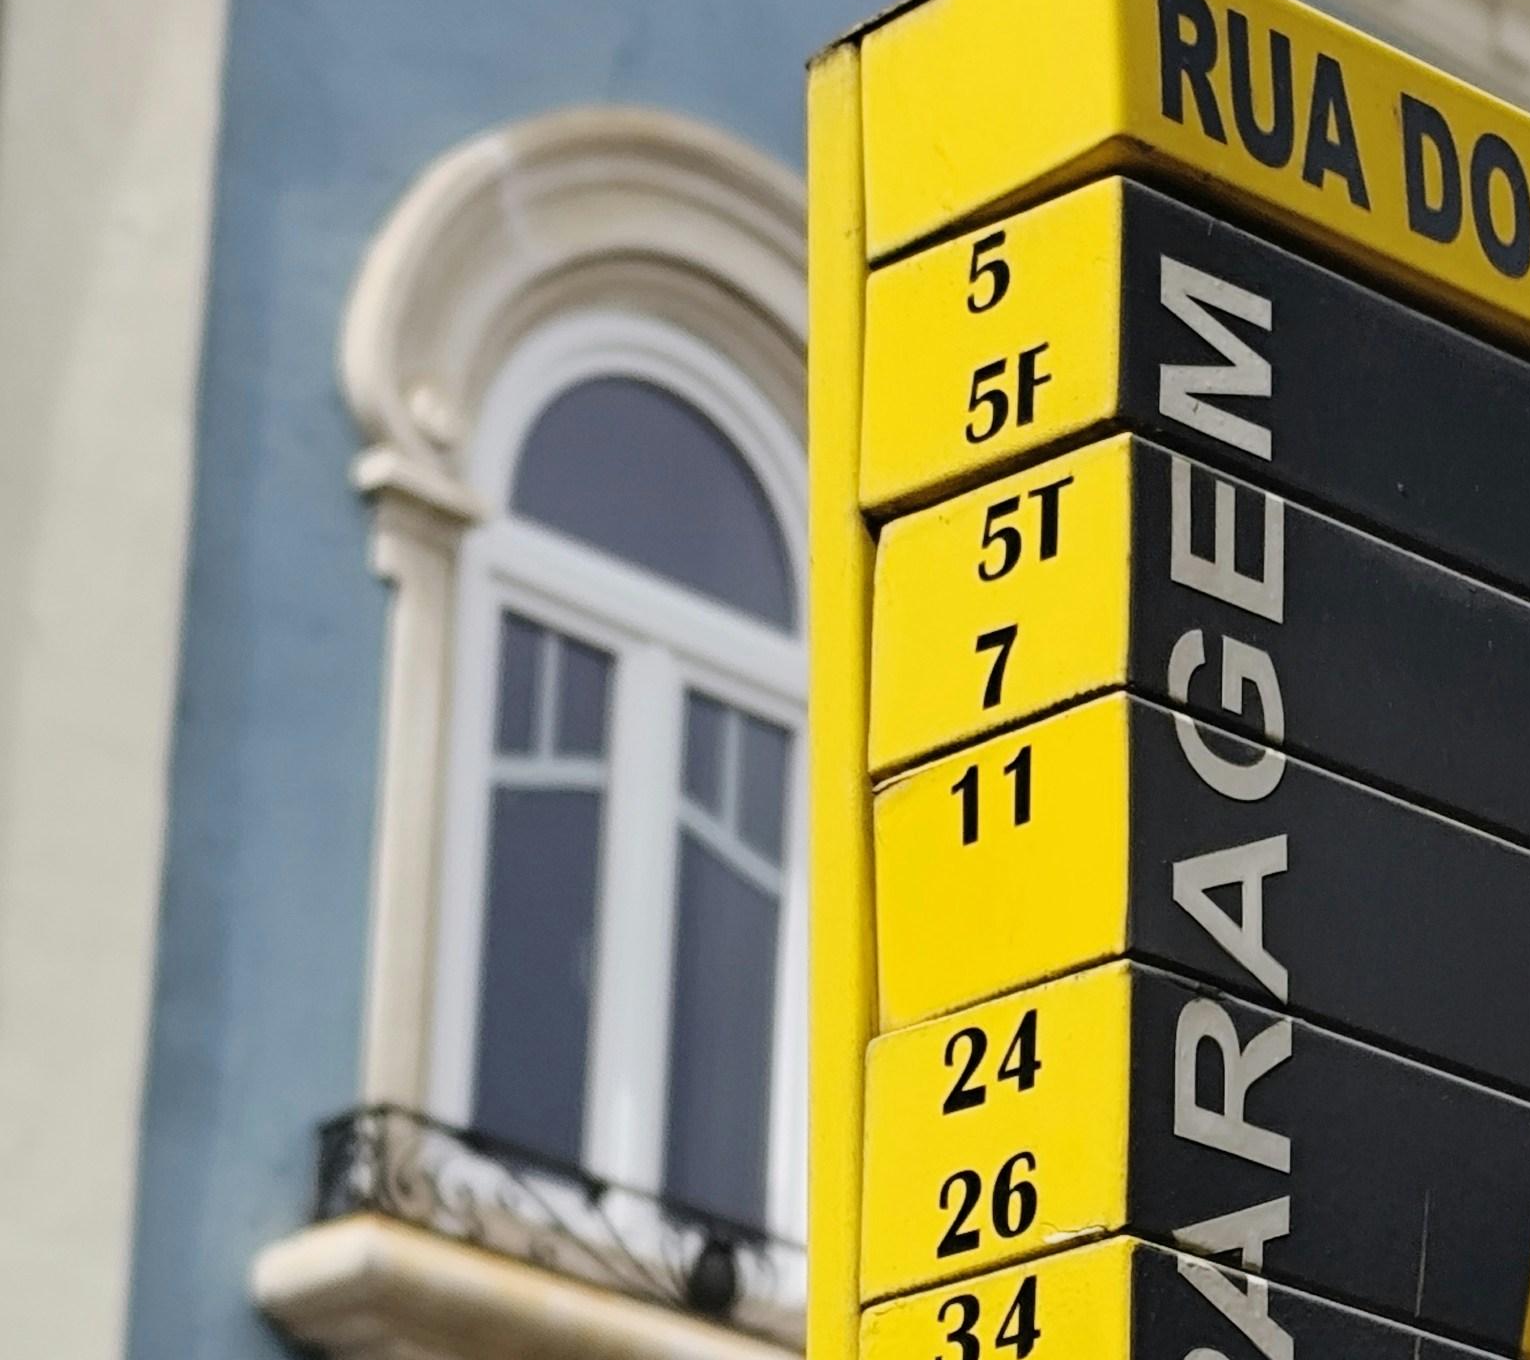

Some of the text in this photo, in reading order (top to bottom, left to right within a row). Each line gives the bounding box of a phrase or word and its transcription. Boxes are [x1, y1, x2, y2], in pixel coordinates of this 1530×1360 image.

[967, 230, 1010, 313] 5
[966, 344, 1051, 443] 5F
[978, 476, 1074, 581] 5T
[976, 625, 1018, 709] 7
[952, 746, 1031, 845] 11
[943, 1009, 1041, 1114] 24
[937, 1151, 1037, 1258] 26
